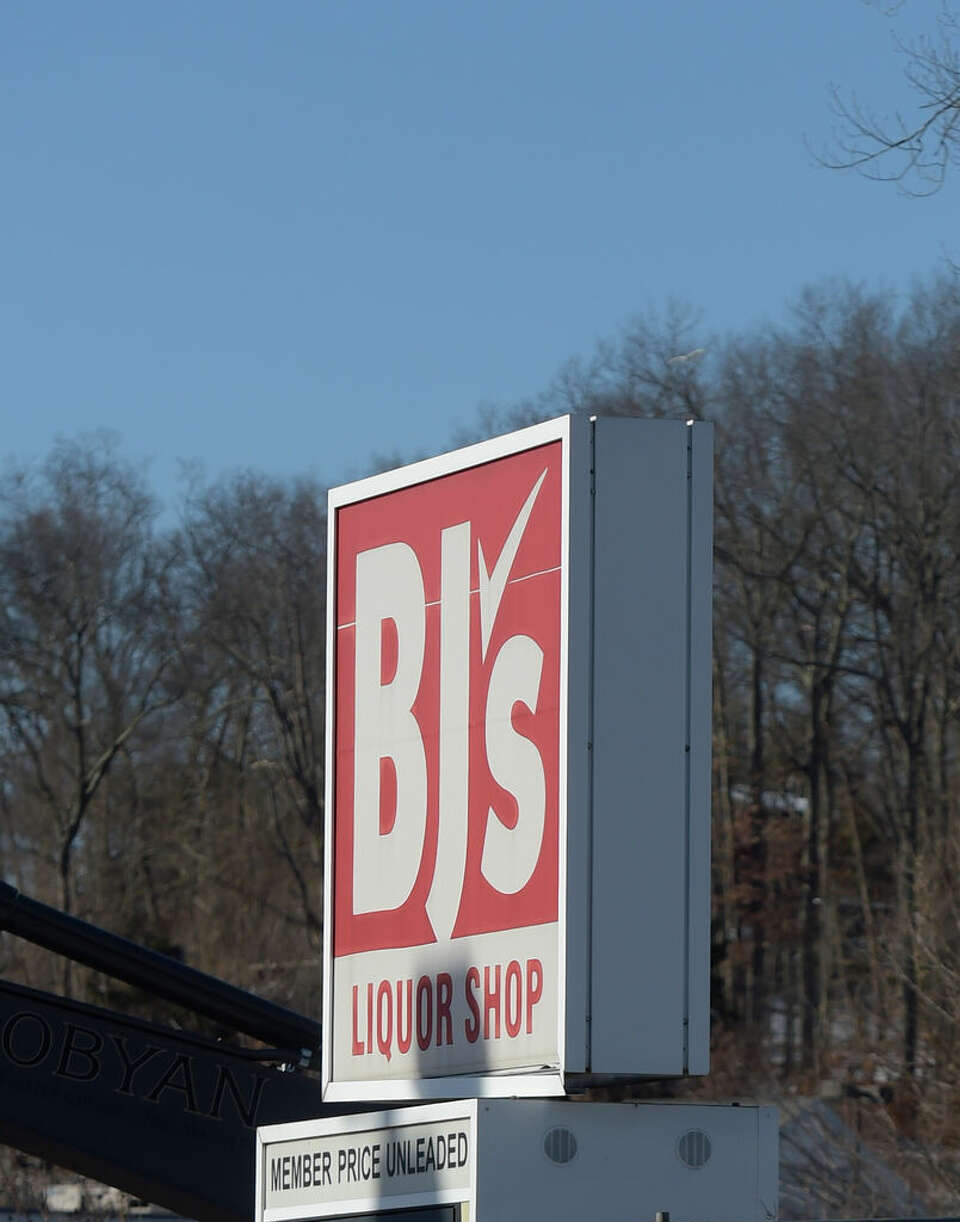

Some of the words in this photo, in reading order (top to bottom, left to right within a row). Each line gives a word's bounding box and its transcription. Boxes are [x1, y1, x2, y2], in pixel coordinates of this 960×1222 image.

[351, 977, 453, 1062] LIQUOR
[464, 958, 543, 1045] SHOP
[271, 1151, 332, 1191] MEMBER
[338, 1144, 381, 1184] PRICE
[386, 1132, 468, 1177] UNLEADED
